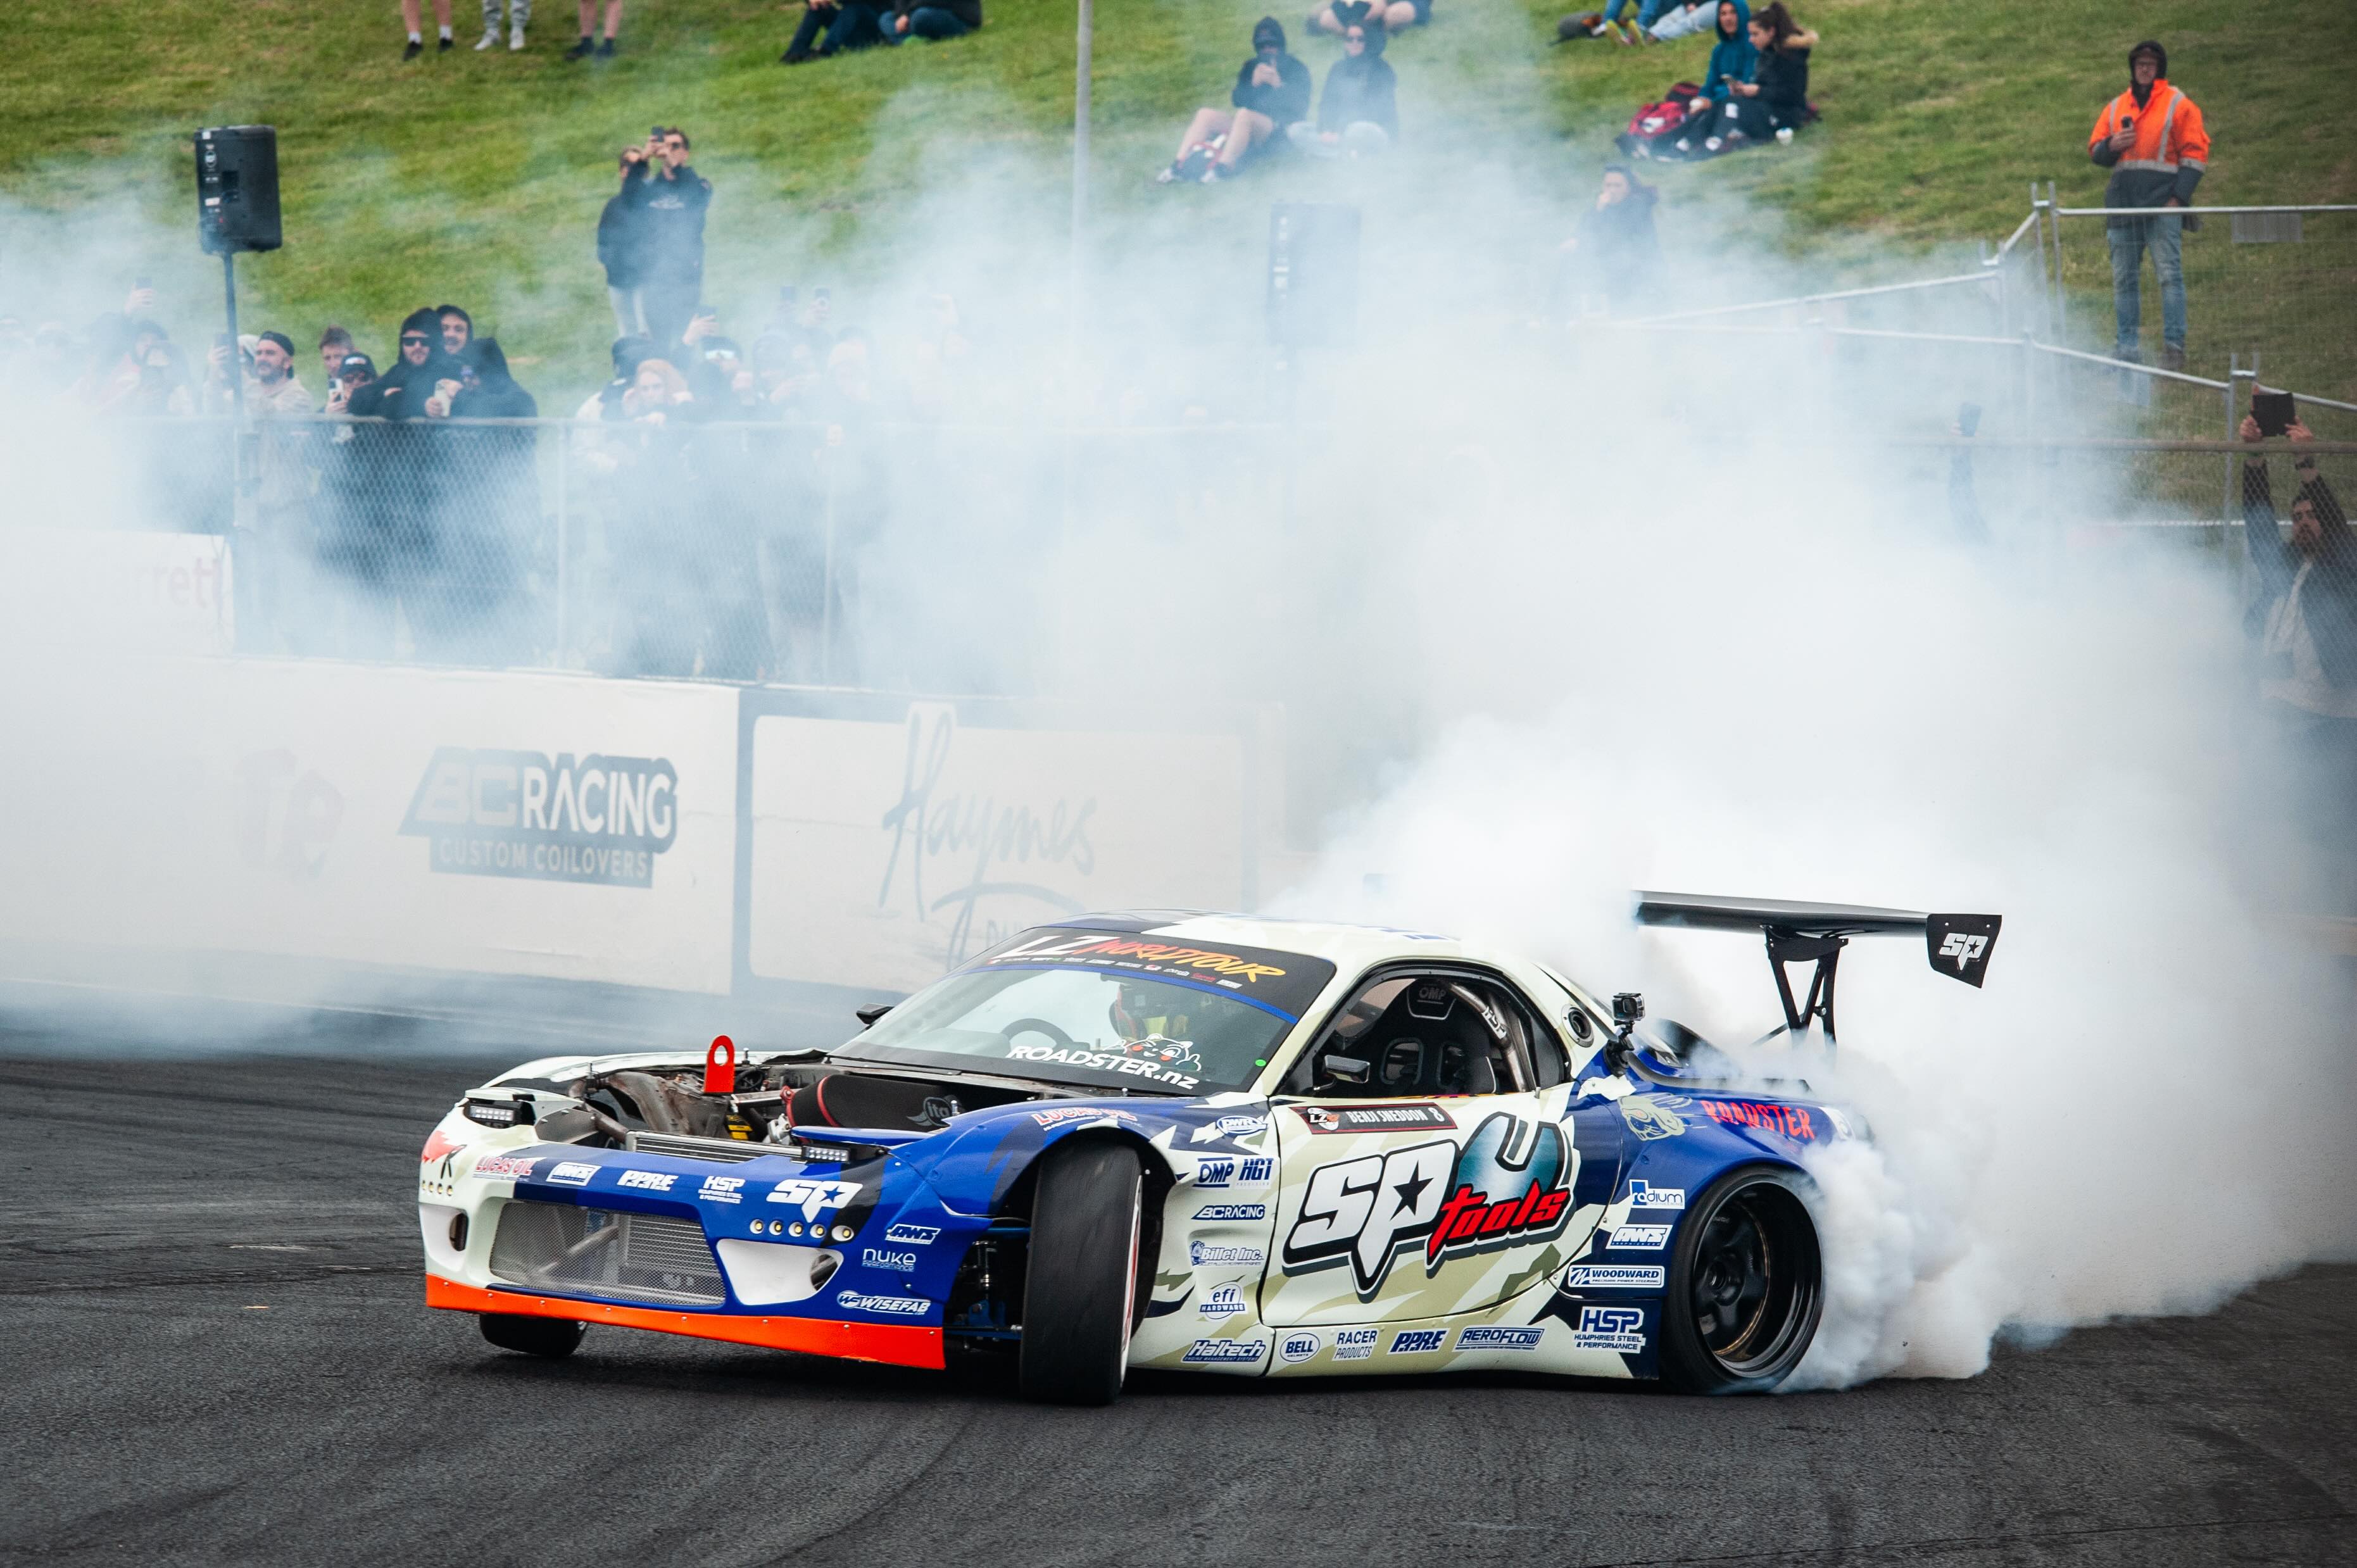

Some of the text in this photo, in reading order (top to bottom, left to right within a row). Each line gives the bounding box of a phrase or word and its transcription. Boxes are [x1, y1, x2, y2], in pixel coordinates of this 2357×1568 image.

[878, 711, 1098, 923] Haymes
[440, 837, 649, 879] CUSTOM COILOVERS
[1939, 933, 1989, 970] SP
[1005, 1046, 1200, 1090] ROADSTER.nz
[1346, 1111, 1380, 1123] BENJI
[1378, 1109, 1429, 1122] SNEDDON
[1428, 1107, 1445, 1122] 8
[1198, 1162, 1235, 1183] OMP
[1238, 1158, 1274, 1181] HGT
[703, 1176, 746, 1192] HSP
[766, 1179, 864, 1224] SP
[1633, 1190, 1683, 1203] radium
[1289, 1143, 1457, 1279] SP
[1428, 1181, 1569, 1258] tools
[863, 1248, 917, 1265] nuke
[1201, 1248, 1238, 1260] Billet
[1592, 1270, 1659, 1278] WOODWARD
[1212, 1288, 1236, 1302] efi
[860, 1298, 931, 1312] WISEFAB
[1581, 1309, 1640, 1333] HSP
[1336, 1330, 1378, 1345] RACER
[1459, 1329, 1541, 1344] AEROFLOW
[1188, 1340, 1266, 1356] Haltech
[1285, 1341, 1313, 1353] BELL
[1335, 1346, 1373, 1359] PRODUCTS
[1583, 1342, 1638, 1350] PERFORMANCE
